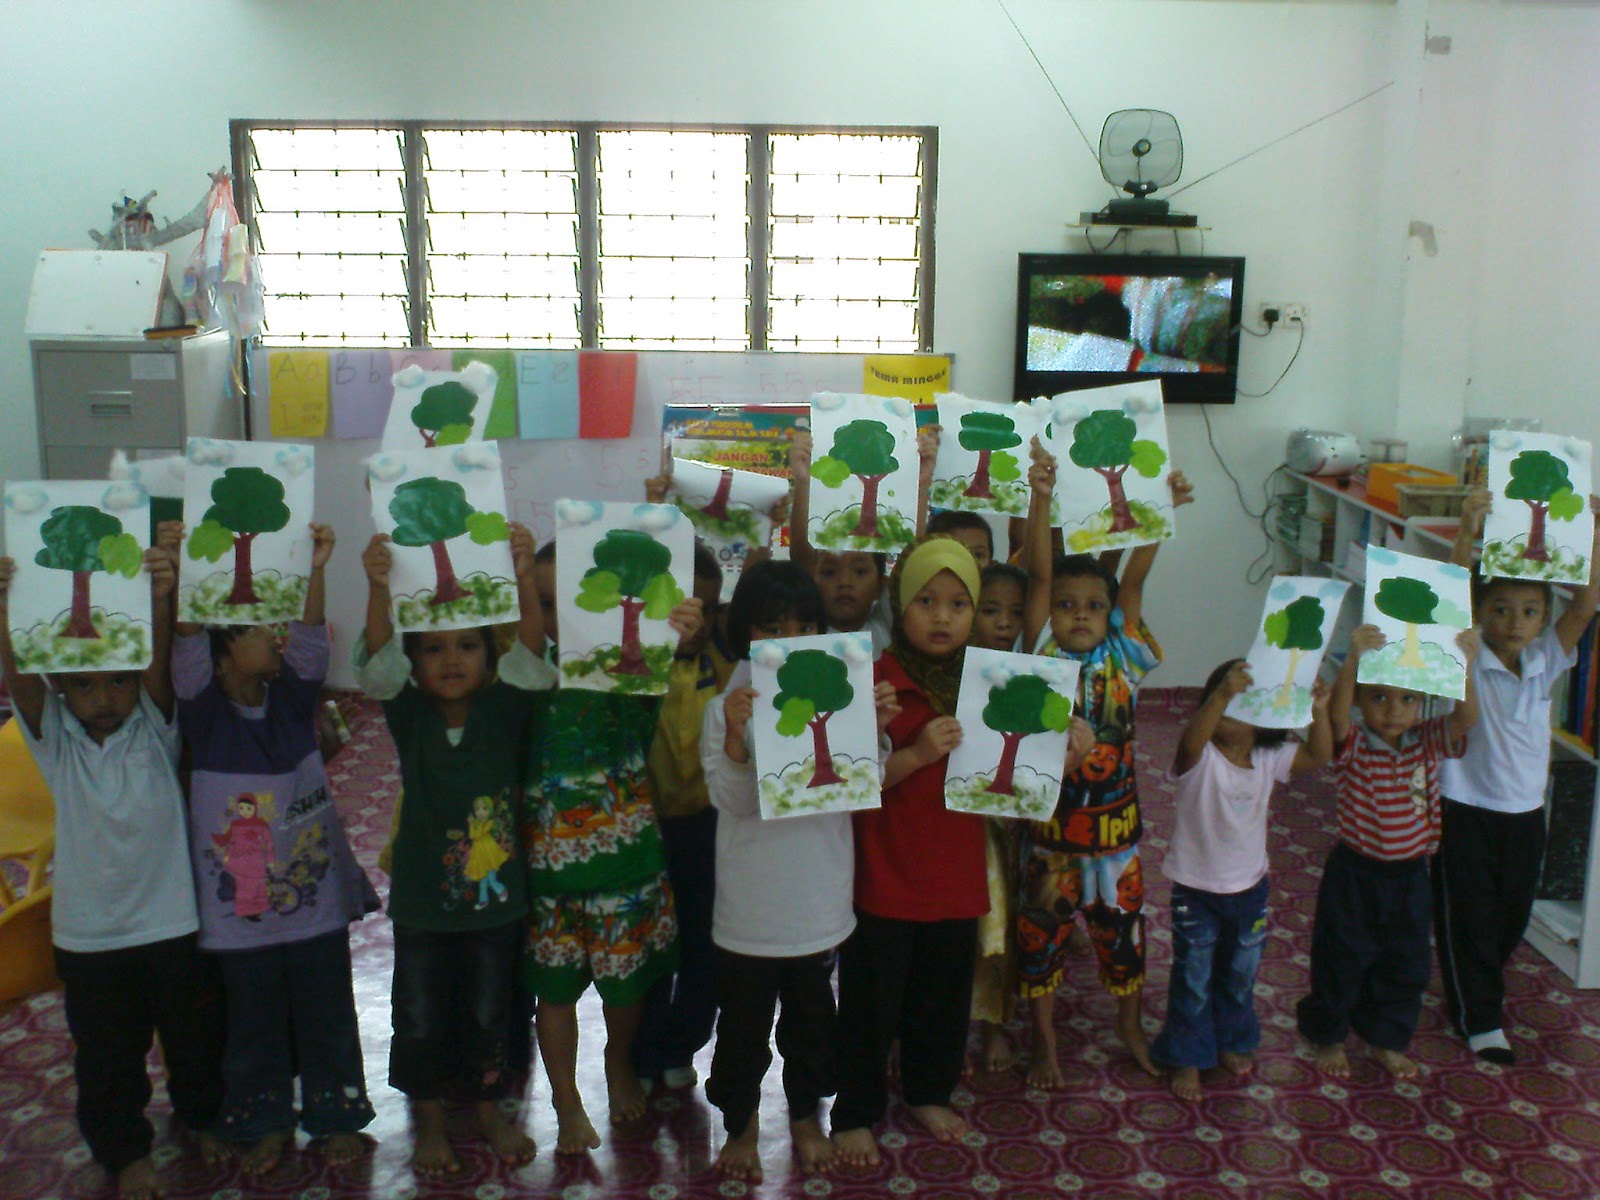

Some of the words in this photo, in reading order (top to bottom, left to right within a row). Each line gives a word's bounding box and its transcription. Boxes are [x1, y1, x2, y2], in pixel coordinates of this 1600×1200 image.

[274, 354, 298, 381] A
[335, 352, 357, 385] B
[368, 353, 382, 385] b
[520, 355, 540, 385] E
[715, 451, 769, 463] JANGAN
